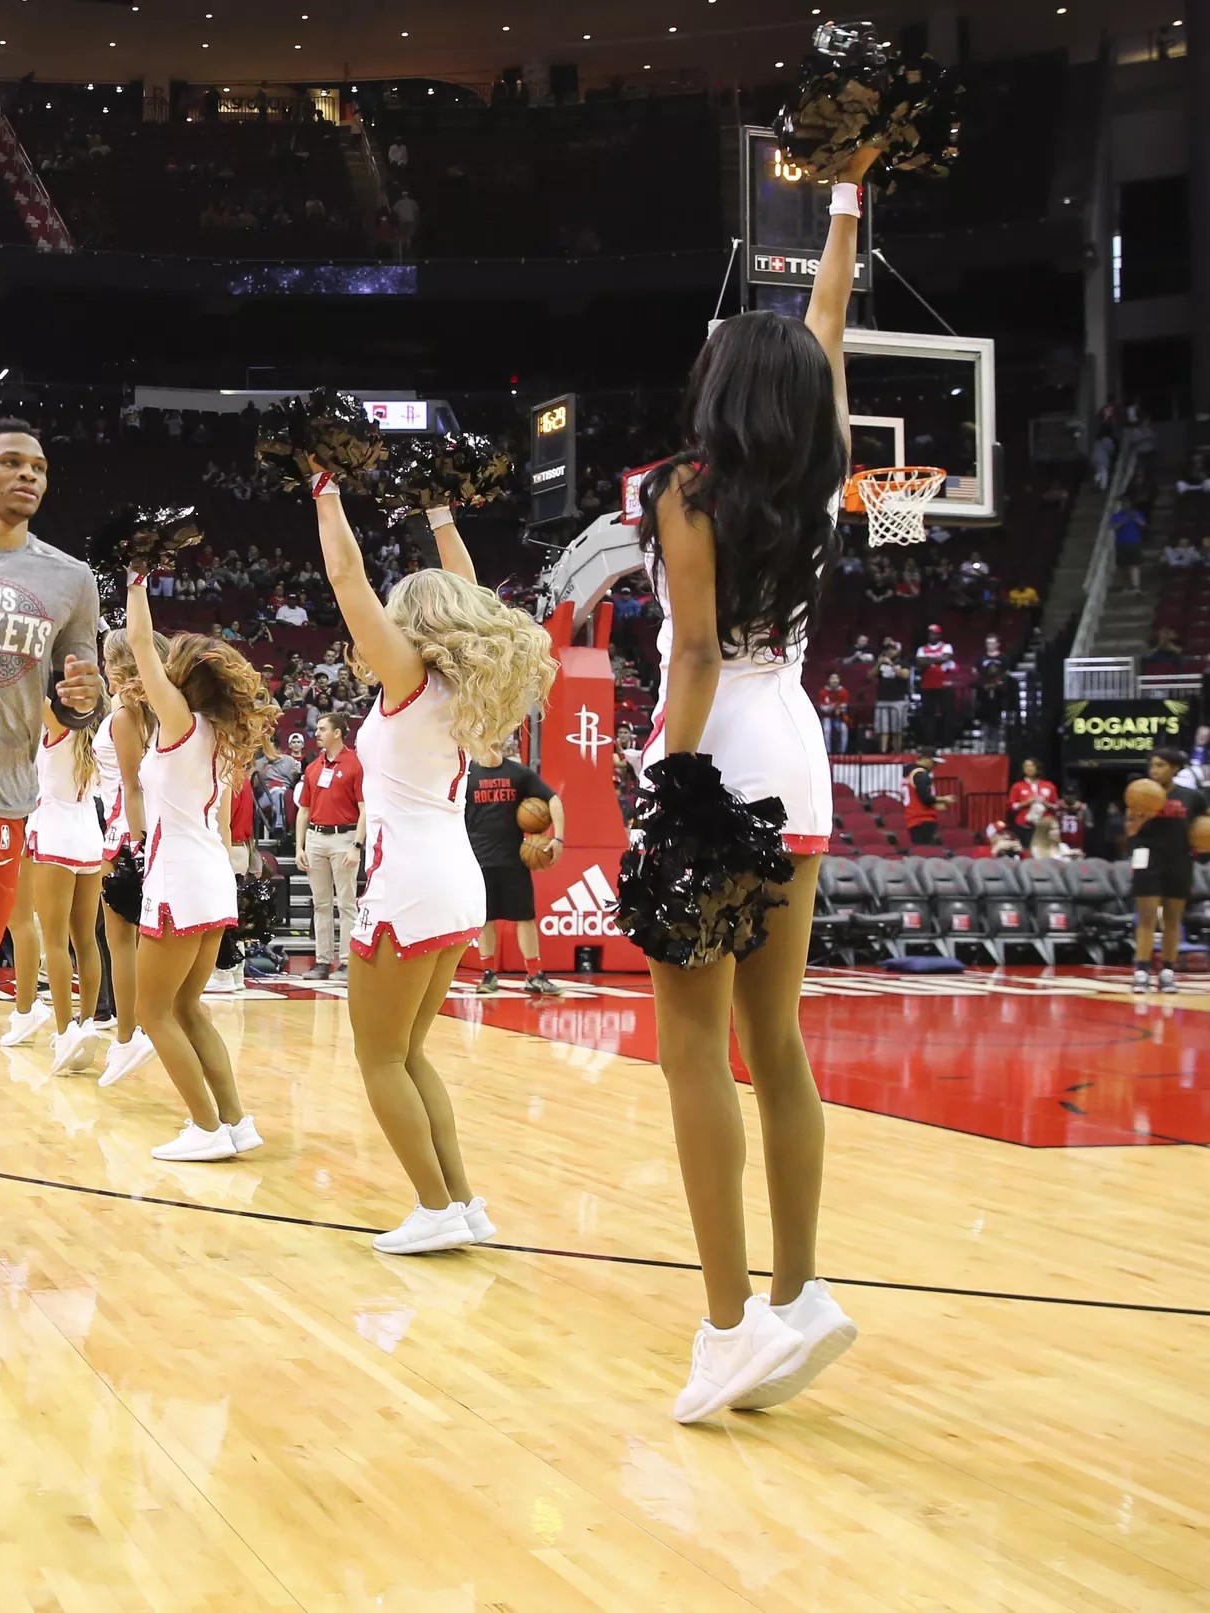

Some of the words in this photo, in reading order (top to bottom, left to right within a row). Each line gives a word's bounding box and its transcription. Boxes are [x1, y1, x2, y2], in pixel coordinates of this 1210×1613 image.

[785, 257, 865, 279] TIST
[1073, 716, 1180, 735] BOGART'S
[1093, 737, 1155, 751] LOUNGE
[478, 777, 511, 789] HOUSTON
[474, 788, 517, 804] ROCKETS
[539, 909, 622, 937] adida
